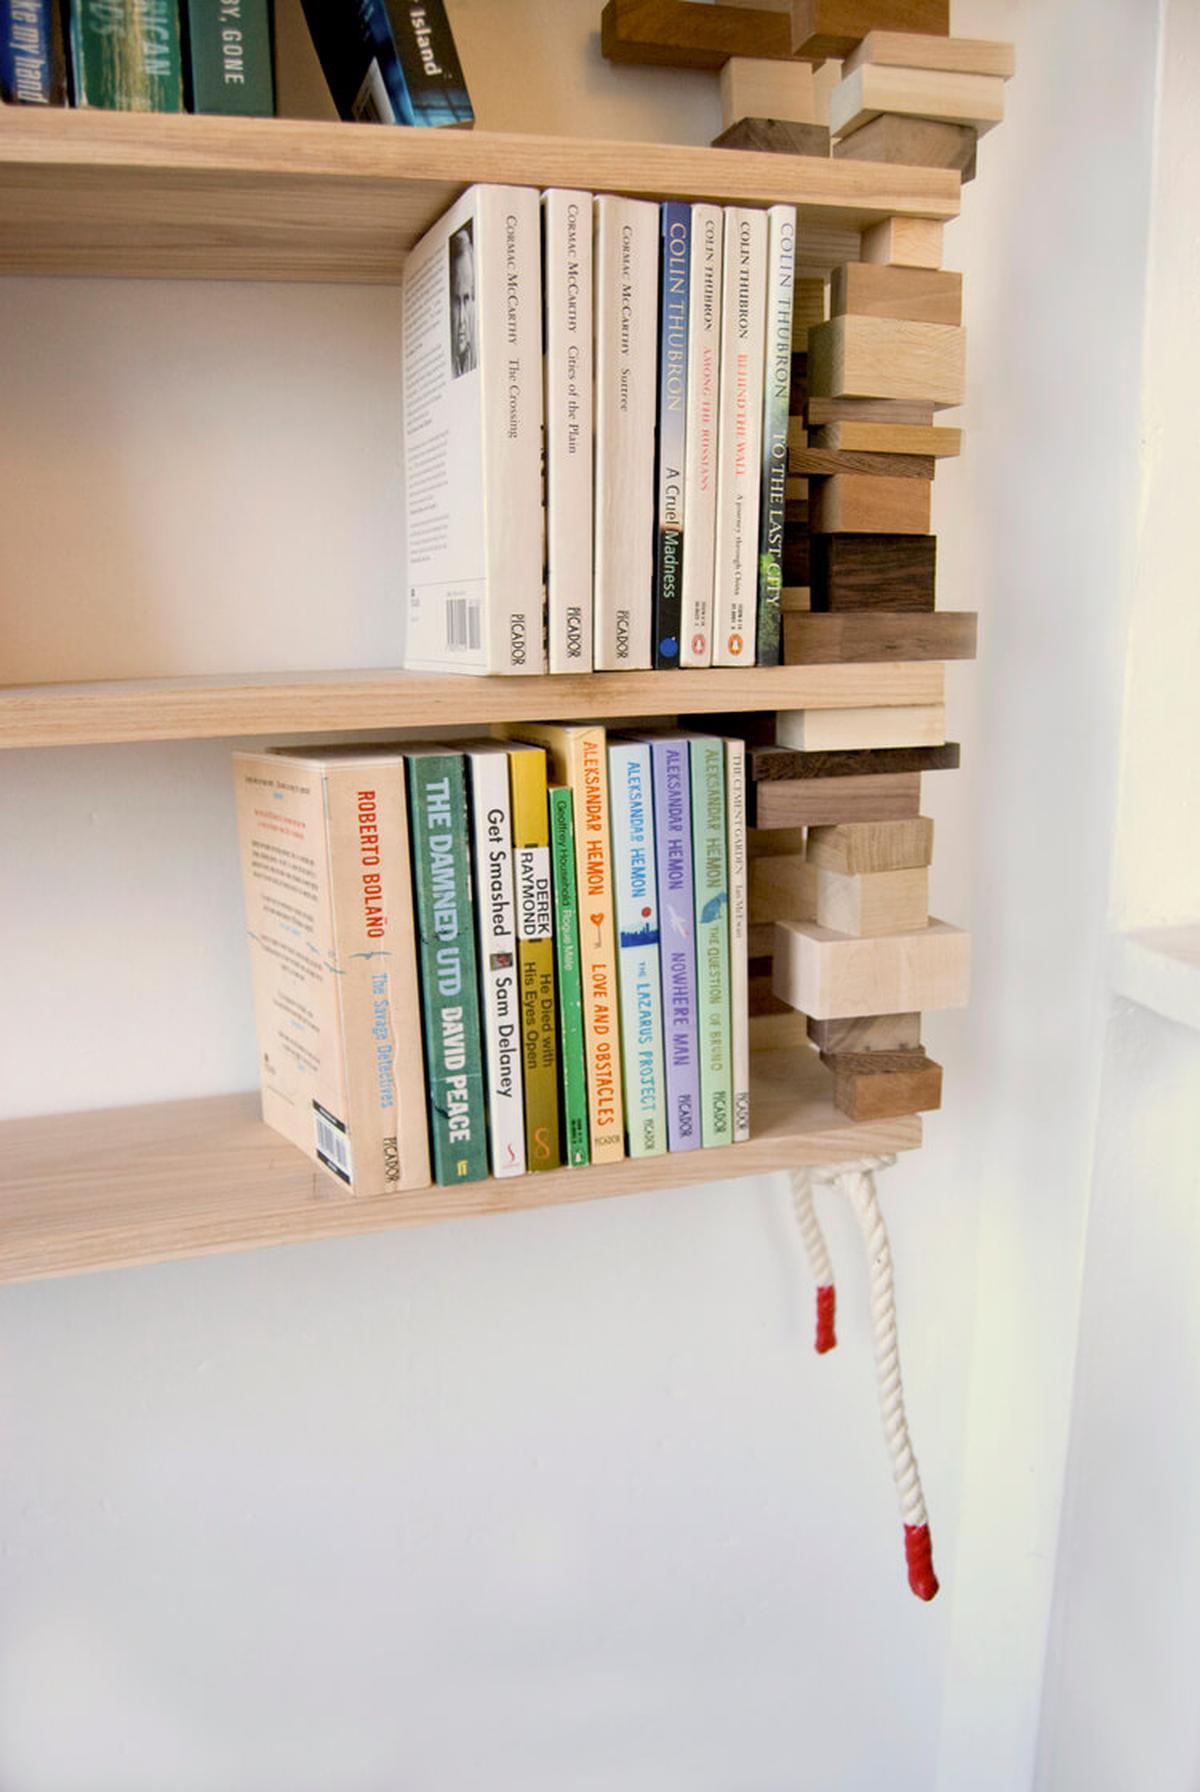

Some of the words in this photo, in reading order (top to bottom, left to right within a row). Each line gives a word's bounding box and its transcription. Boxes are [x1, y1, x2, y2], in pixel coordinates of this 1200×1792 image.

[9, 24, 40, 54] my
[222, 29, 245, 85] GONE
[409, 10, 443, 77] Island
[15, 56, 49, 104] hand
[506, 214, 518, 269] CORMAC
[567, 204, 579, 258] CORMAC
[621, 225, 632, 279] CORMAC
[704, 219, 715, 262] COLIN
[739, 220, 751, 265] COLIN
[779, 222, 793, 288] COLIN
[669, 222, 687, 294] COLIN
[703, 266, 714, 332] THUBRON
[738, 269, 750, 340] THUBRON
[508, 358, 520, 381] The
[567, 345, 579, 379] Cities
[667, 301, 687, 411] THUBRON
[774, 298, 791, 399] THUBRON
[508, 383, 520, 438] Crossing
[568, 384, 580, 398] of
[568, 401, 580, 420] the
[619, 368, 631, 412] Suttree
[568, 424, 580, 454] Plain
[735, 442, 747, 477] WALL
[771, 434, 786, 458] TO
[665, 467, 680, 479] A
[769, 464, 785, 503] THE
[664, 485, 680, 524] Cruel
[767, 509, 784, 556] LAST
[662, 528, 680, 598] Madness
[765, 562, 782, 608] CITY
[511, 613, 526, 666] PICADOR
[567, 607, 582, 658] PICADOR
[616, 609, 630, 659] PICADOR
[583, 740, 603, 832] ALEKSANDAR
[732, 754, 743, 775] THE
[425, 776, 451, 830] THE
[627, 761, 645, 842] ALEKSANDAR
[666, 750, 683, 832] ALEKSANDAR
[704, 749, 721, 831] ALEKSANDAR
[733, 777, 743, 825] CEMENT
[356, 790, 380, 867] ROBERTO
[487, 808, 506, 843] Get
[556, 800, 568, 846] Geoffrey
[586, 840, 605, 897] HEMON
[630, 848, 647, 898] HEMON
[668, 839, 684, 891] HEMON
[705, 837, 722, 889] HEMON
[733, 828, 744, 875] GARDEN
[428, 834, 459, 942] DAMNED
[489, 850, 512, 937] Smashed
[520, 851, 537, 936] RAYMOND
[560, 848, 572, 906] Household
[362, 873, 388, 939] BOLAÑO
[536, 878, 550, 934] DEREK
[561, 909, 575, 946] Rogue
[708, 926, 720, 946] THE
[371, 972, 388, 995] The
[436, 947, 462, 997] UTD
[523, 961, 537, 986] His
[539, 973, 551, 993] He
[590, 963, 608, 998] LOVE
[637, 961, 647, 977] THE
[671, 952, 690, 1026] NOWHERE
[707, 947, 722, 1005] QUESTION
[371, 999, 390, 1041] Savage
[495, 976, 512, 1018] Sam
[523, 990, 538, 1025] Eyes
[541, 1002, 553, 1030] Died
[592, 1003, 610, 1036] AND
[636, 983, 653, 1045] LAZARUS
[441, 1006, 466, 1071] DAVID
[496, 1024, 517, 1098] Delaney
[526, 1027, 539, 1070] Open
[541, 1034, 555, 1068] with
[672, 1033, 690, 1067] MAN
[709, 1031, 724, 1072] BRUNO
[376, 1044, 395, 1110] Detectives
[594, 1041, 616, 1127] OBSTACLES
[638, 1050, 657, 1112] PROJECT
[445, 1074, 471, 1144] PEACE
[678, 1094, 693, 1140] PICADOR
[711, 1091, 727, 1135] PICADOR
[383, 1136, 401, 1184] PICADOR
